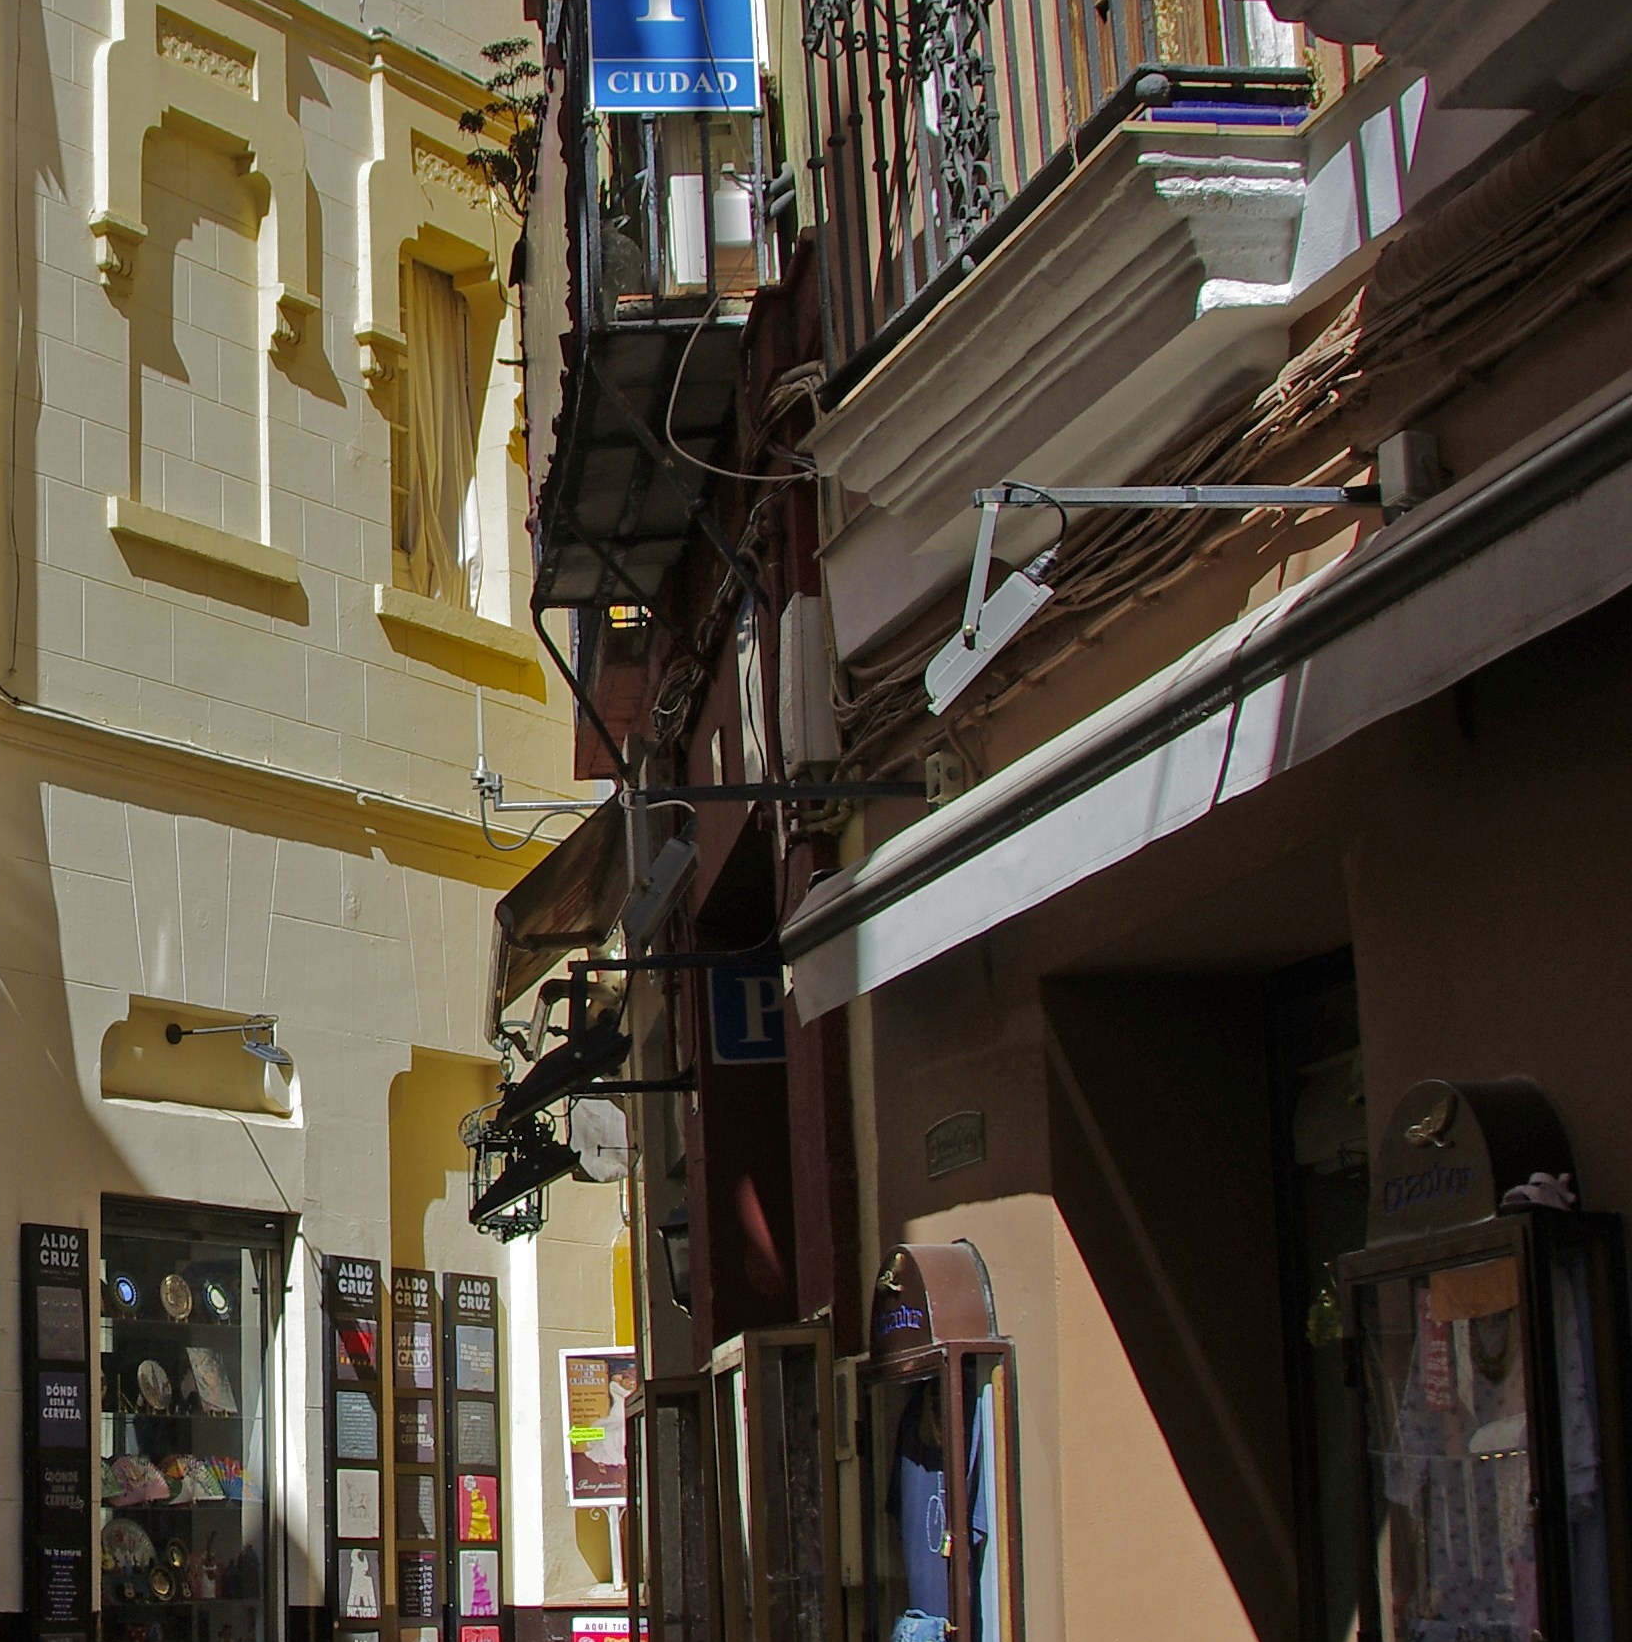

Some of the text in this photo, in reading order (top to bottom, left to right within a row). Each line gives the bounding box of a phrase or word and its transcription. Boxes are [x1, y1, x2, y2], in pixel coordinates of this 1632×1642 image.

[607, 71, 738, 94] CIUDAD
[736, 976, 784, 1043] P
[40, 1233, 80, 1250] ALDO
[39, 1250, 80, 1268] CRUZ
[338, 1263, 374, 1278] ALDO
[338, 1279, 374, 1296] CRUZ
[395, 1277, 428, 1293] ALDO
[458, 1279, 491, 1294] ALDO
[395, 1291, 429, 1308] CRUZ
[458, 1295, 491, 1311] CRUZ
[398, 1348, 429, 1366] CALÓ
[45, 1384, 78, 1397] DÓNDE
[42, 1406, 82, 1420] CERVEZA
[612, 1623, 628, 1631] TIC
